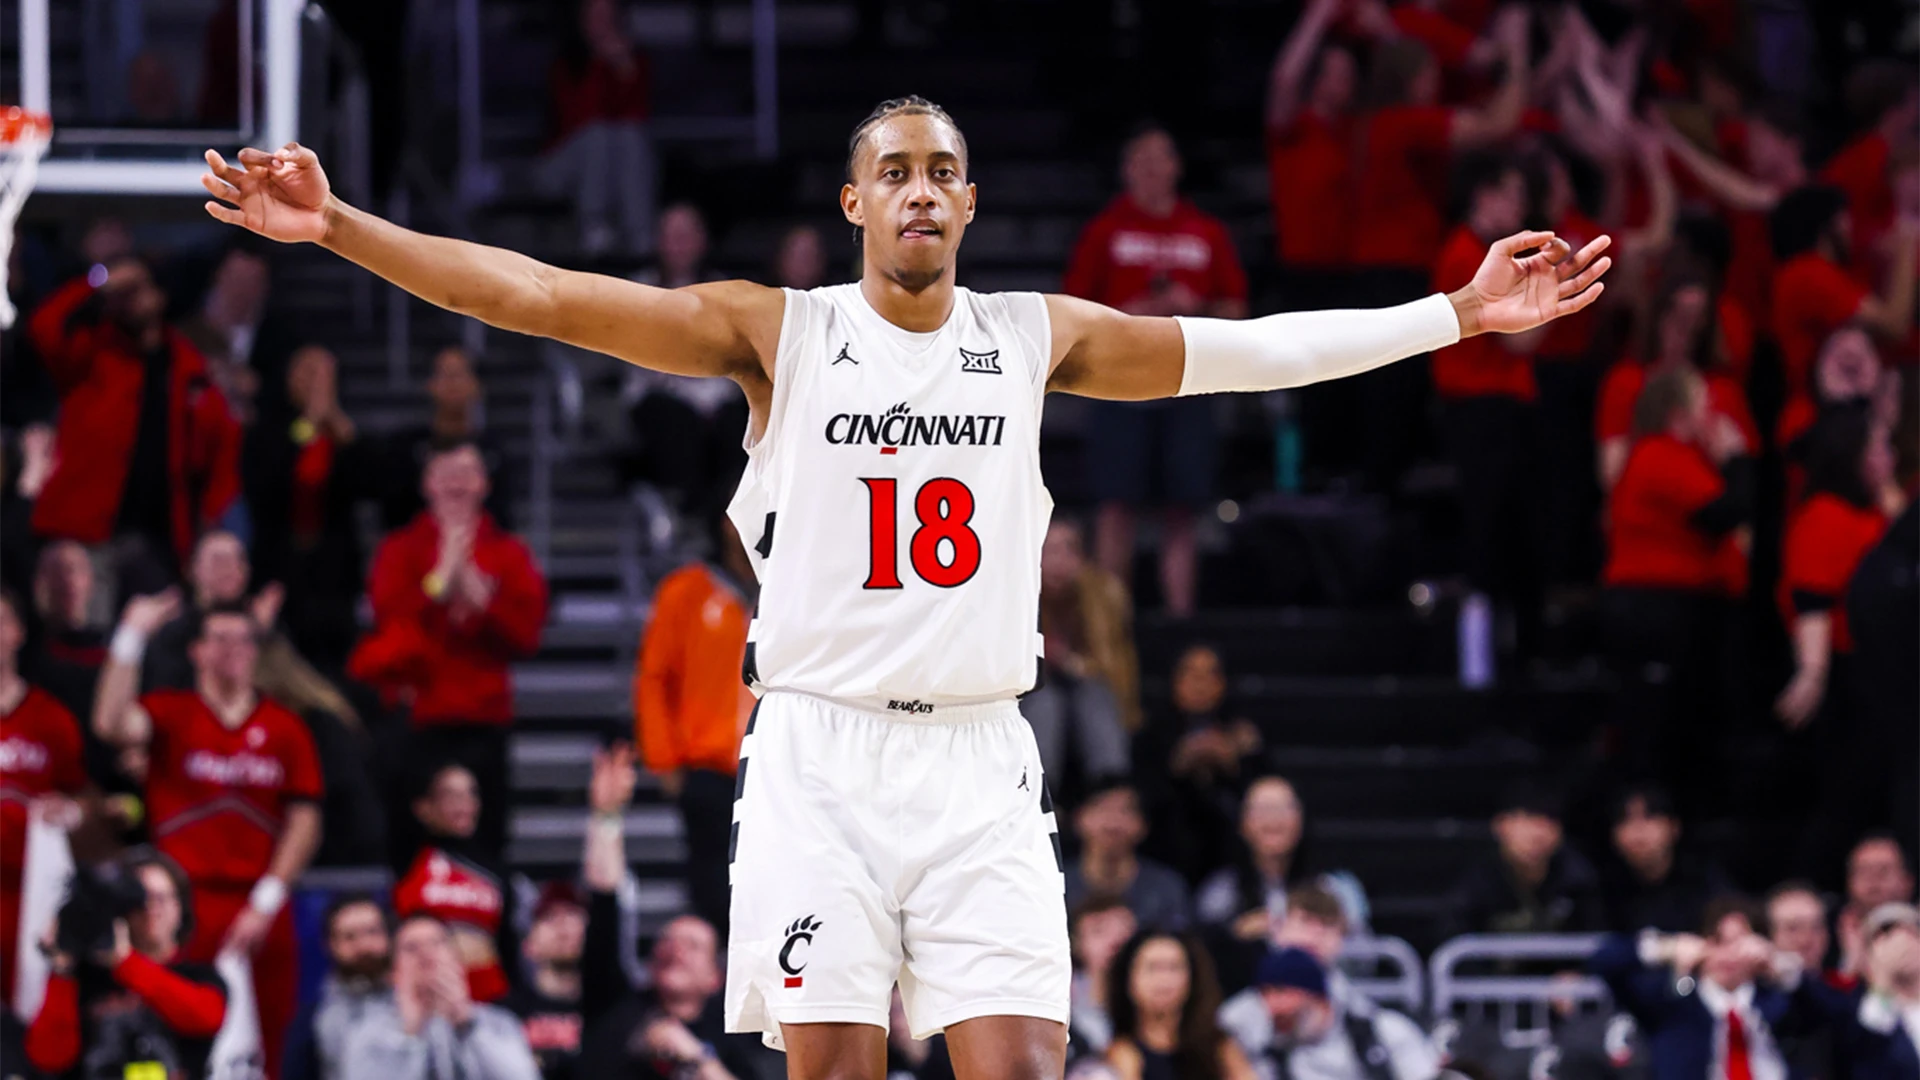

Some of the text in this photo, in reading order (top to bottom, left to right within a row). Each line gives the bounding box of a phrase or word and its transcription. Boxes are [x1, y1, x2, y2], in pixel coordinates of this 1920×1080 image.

[825, 412, 1007, 447] CINCINNATI
[857, 476, 982, 589] 18
[887, 699, 934, 714] BEARCATS
[778, 930, 815, 977] C
